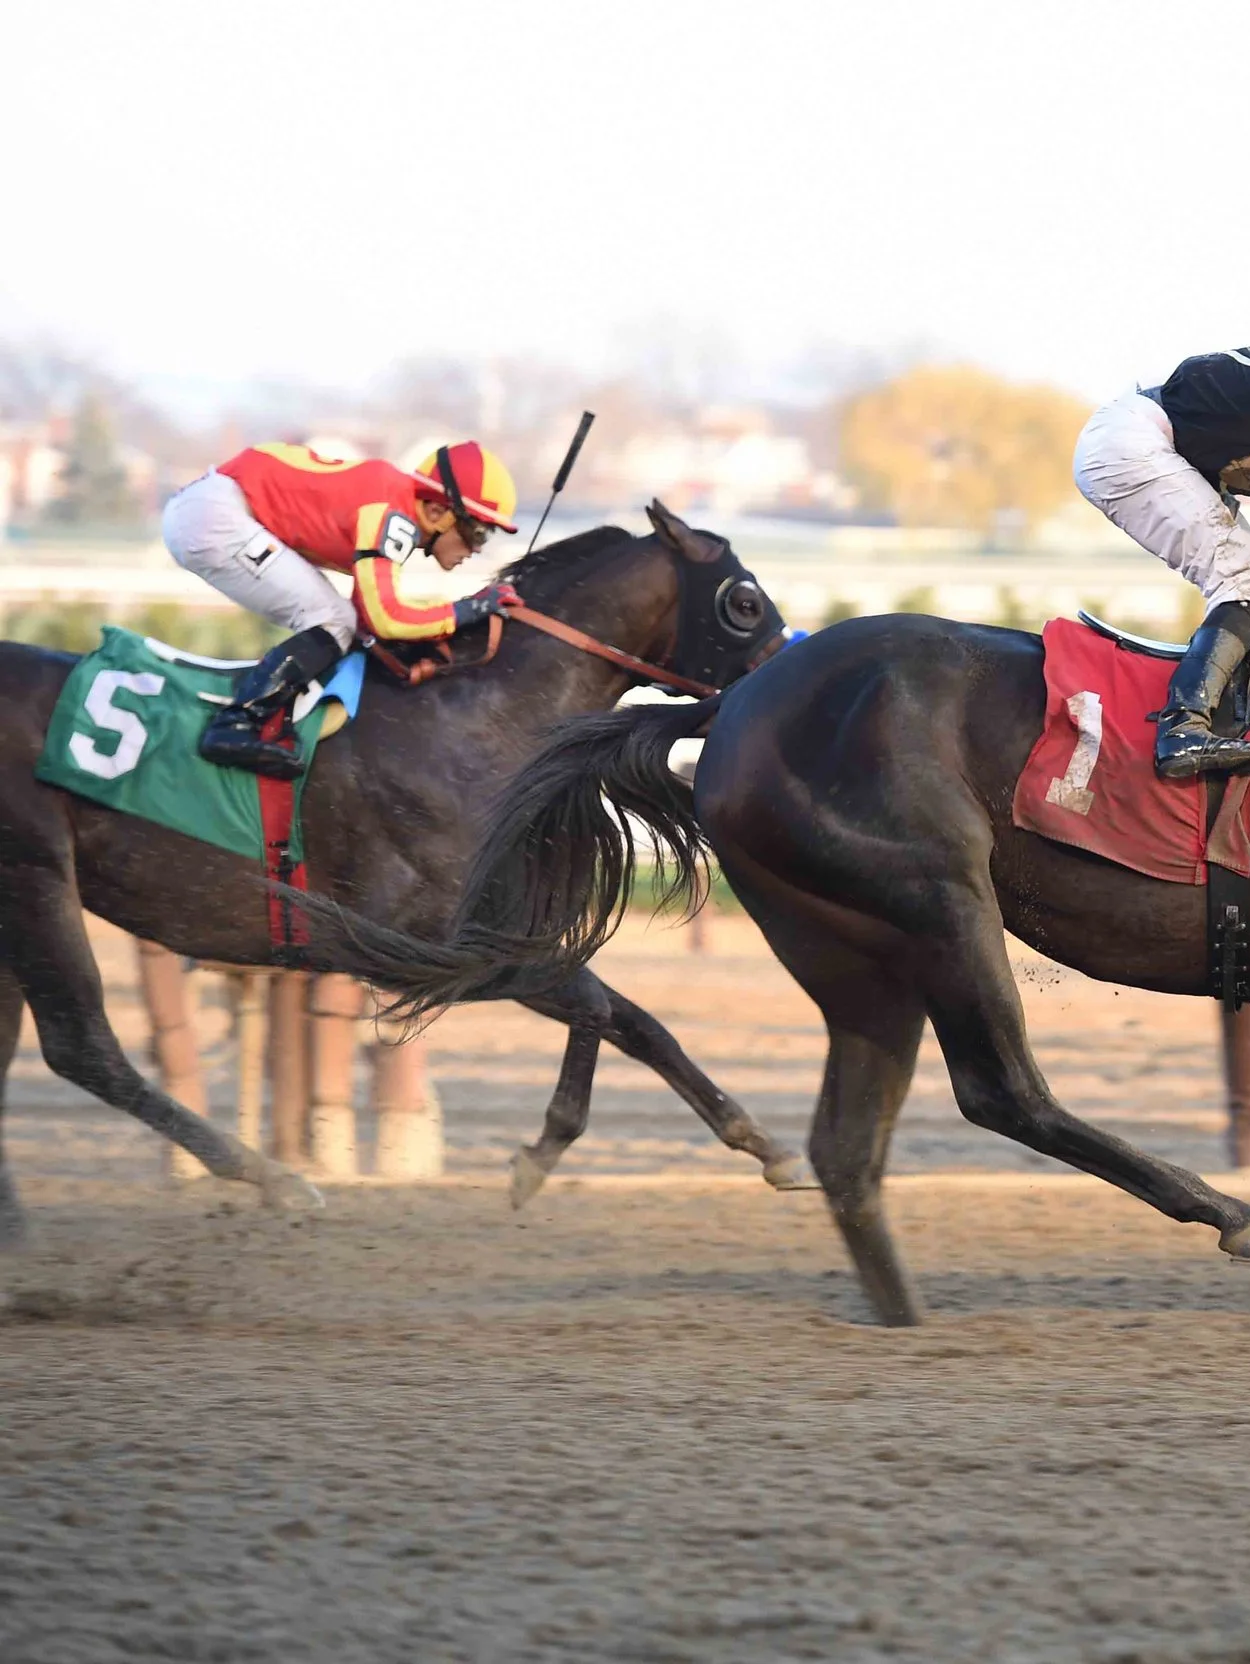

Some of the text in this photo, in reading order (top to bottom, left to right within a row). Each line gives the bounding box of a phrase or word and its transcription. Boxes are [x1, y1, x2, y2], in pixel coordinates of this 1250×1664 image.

[384, 514, 416, 564] 5
[68, 669, 166, 780] 5
[1045, 690, 1103, 816] 1
